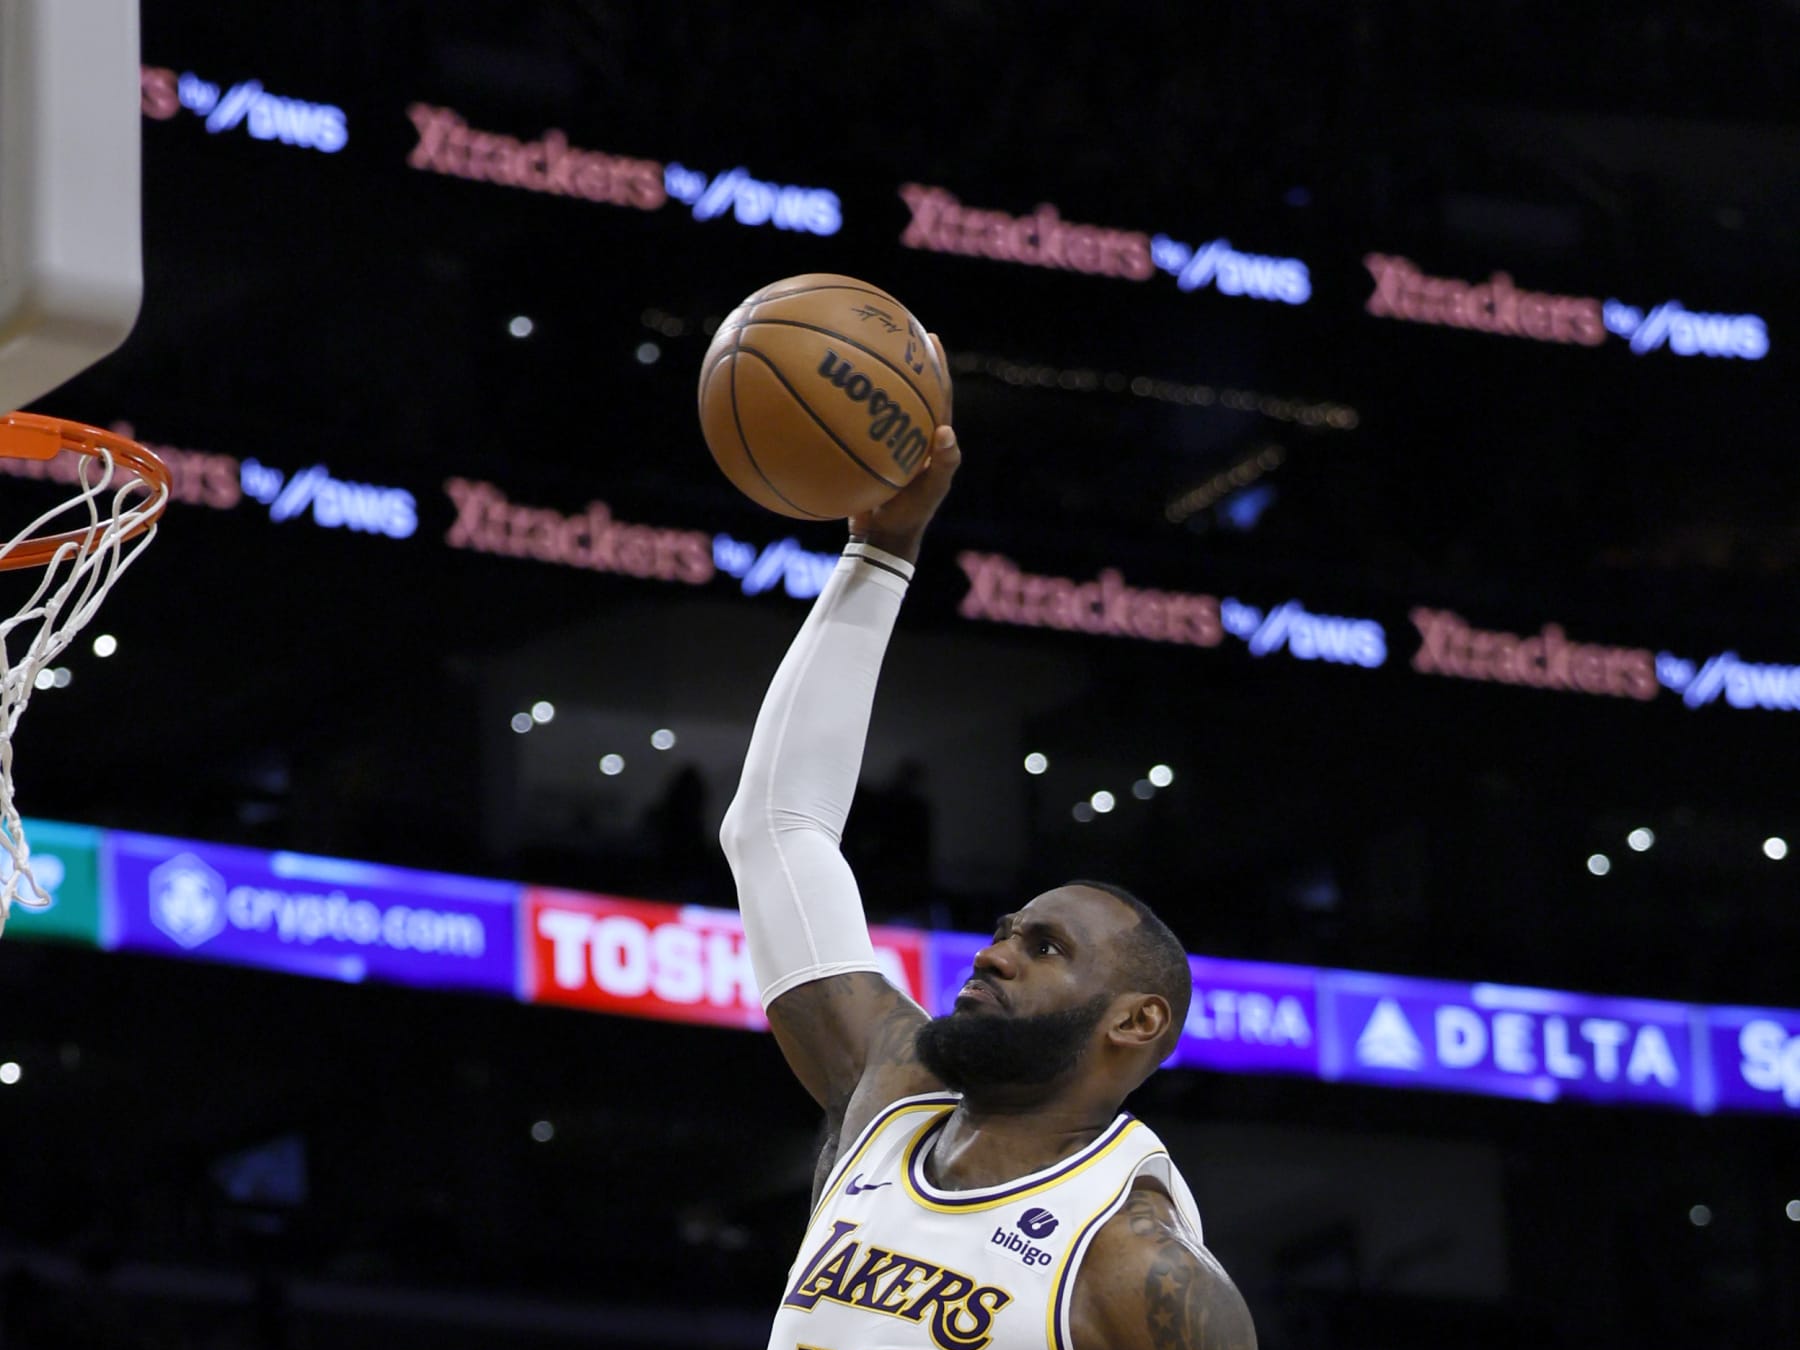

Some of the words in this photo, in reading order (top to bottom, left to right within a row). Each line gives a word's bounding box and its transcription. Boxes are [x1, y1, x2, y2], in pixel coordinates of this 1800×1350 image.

[817, 348, 928, 475] Wilson
[227, 885, 486, 958] crypto.com
[1434, 1004, 1679, 1089] DELTA
[991, 1226, 1053, 1267] bibigo
